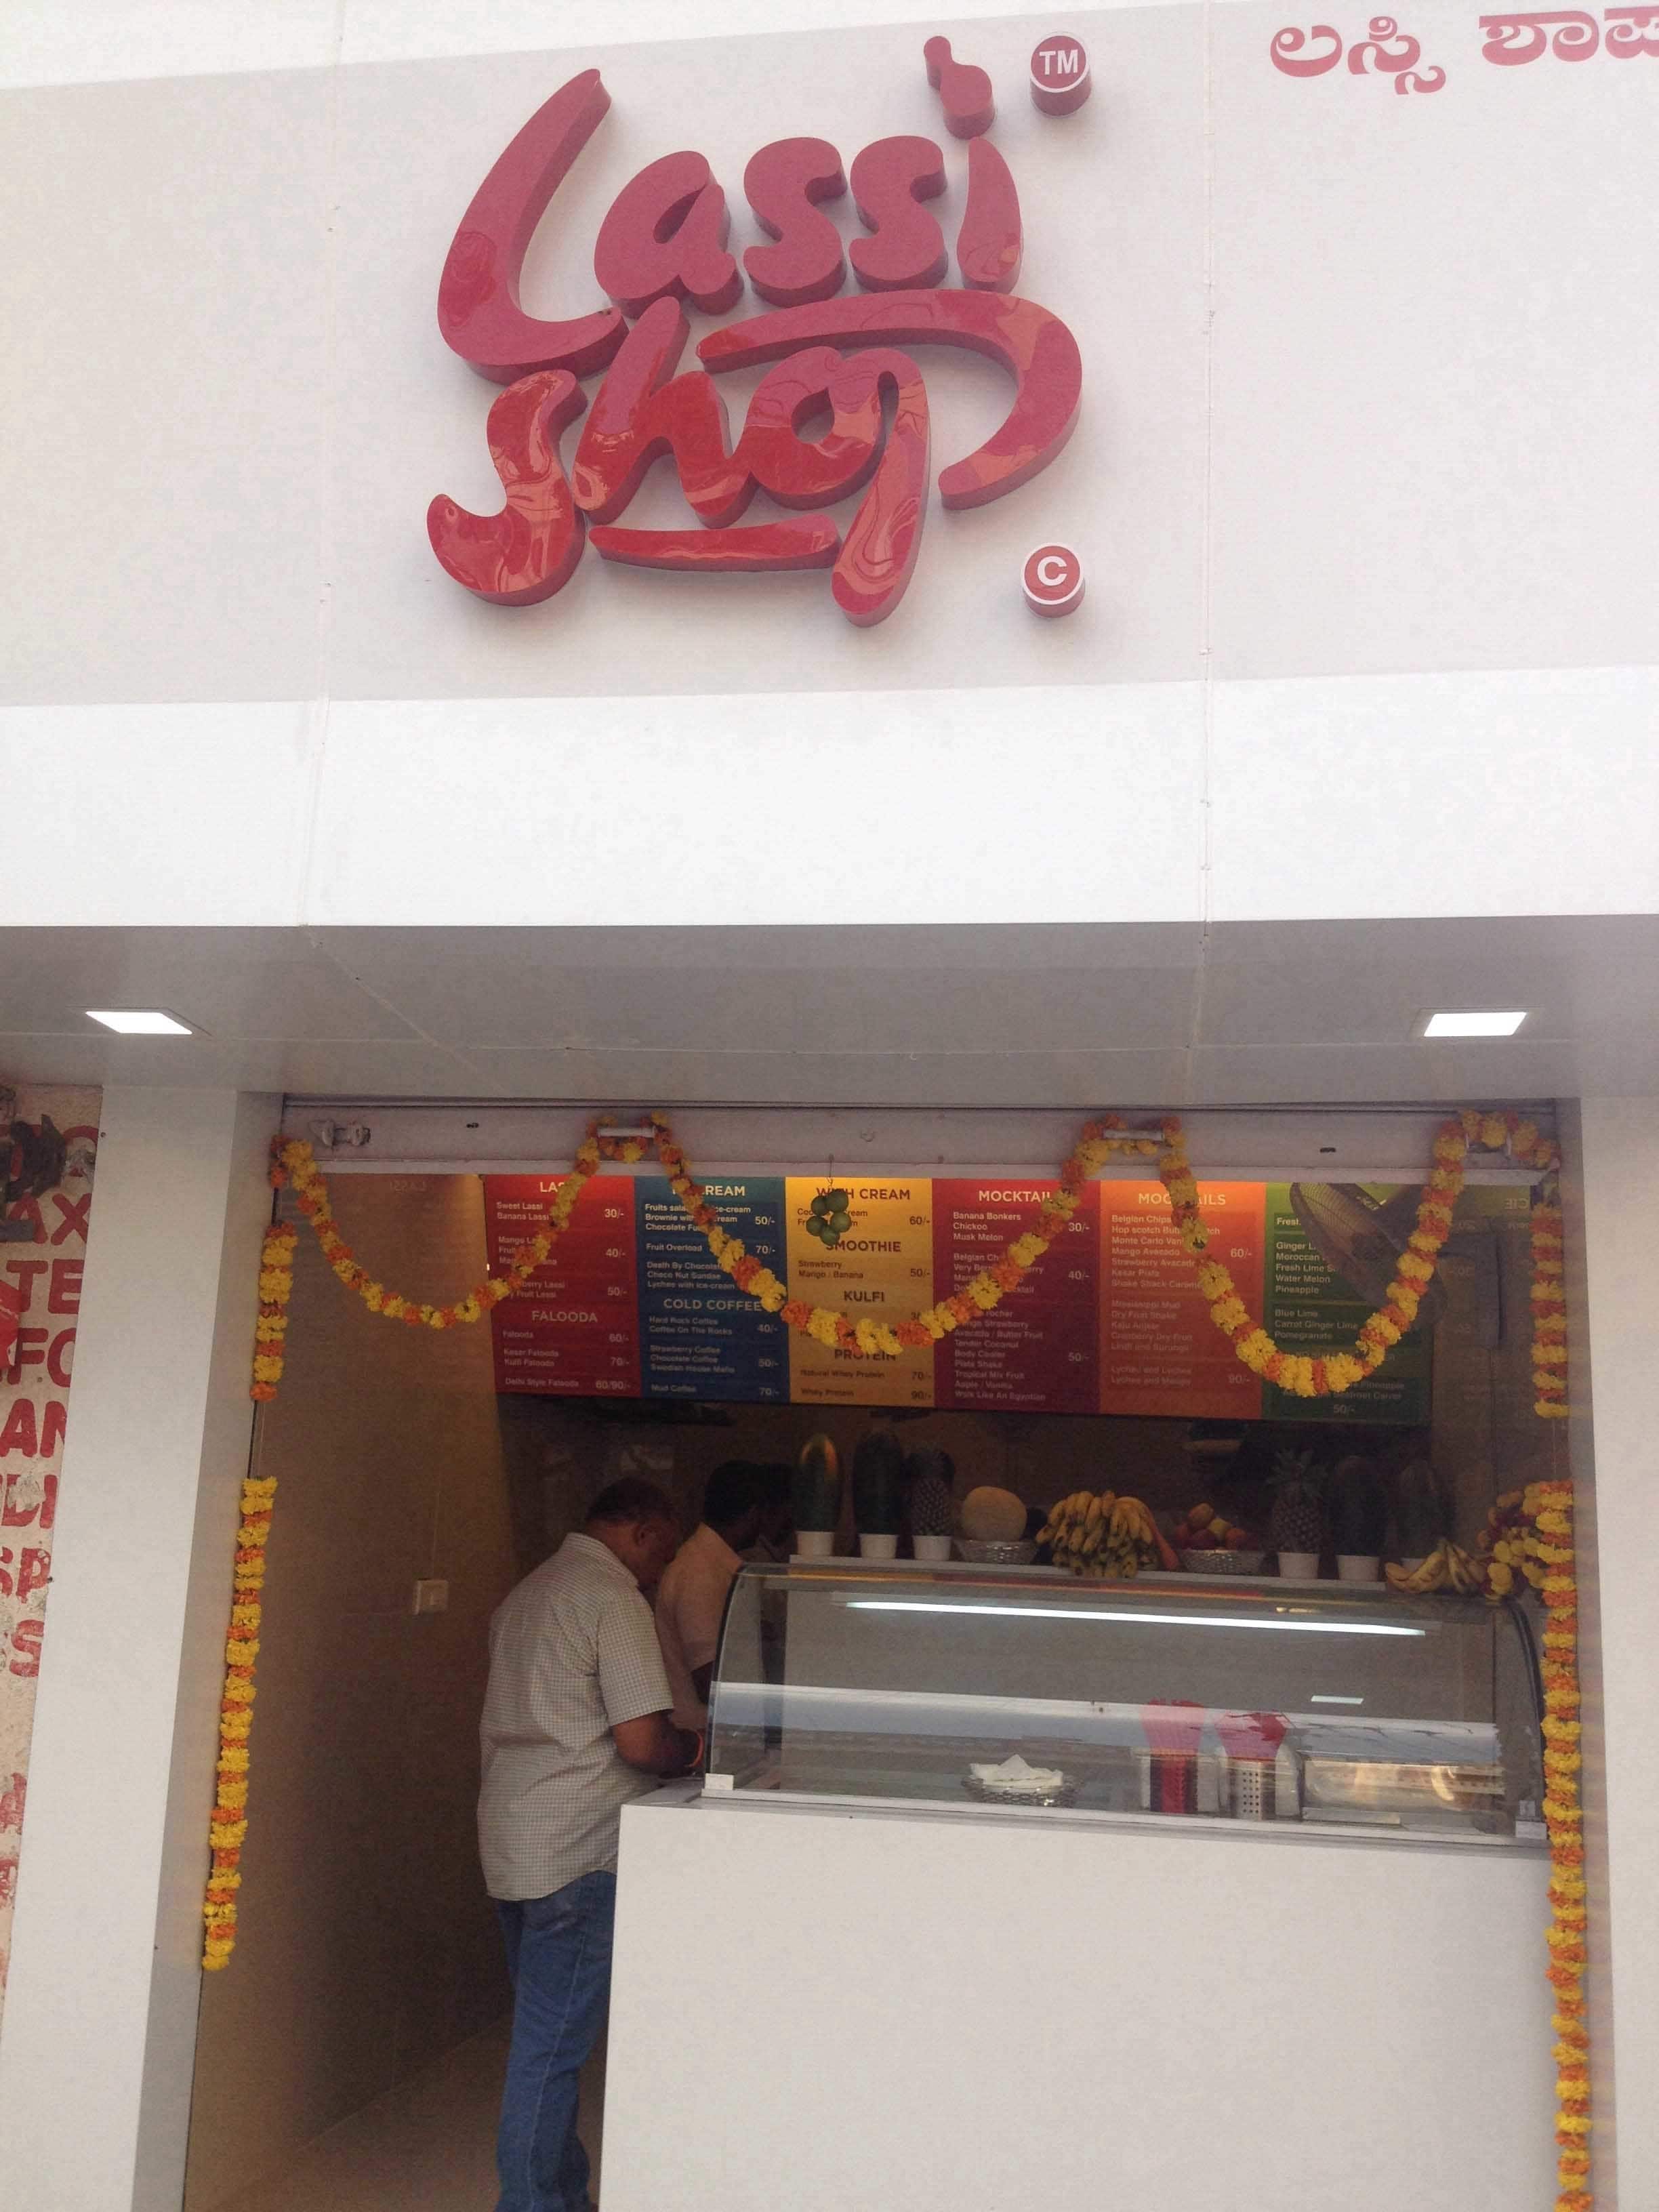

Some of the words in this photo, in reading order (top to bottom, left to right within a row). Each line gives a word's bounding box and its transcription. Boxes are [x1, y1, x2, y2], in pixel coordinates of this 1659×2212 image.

[1039, 49, 1078, 75] TM
[437, 36, 1023, 386] Lassi
[703, 1185, 745, 1197] REAM
[859, 1189, 911, 1200] CREAM
[495, 1201, 520, 1210] Sweet
[522, 1202, 543, 1210] Lassi
[644, 1204, 668, 1212] Fruits
[497, 1212, 527, 1220] Banana
[604, 1208, 624, 1219] 30/-
[953, 1211, 984, 1220] Banana
[987, 1212, 1021, 1221] Bonkers
[754, 1216, 775, 1225] 50/-
[909, 1216, 930, 1225] 60/-
[1111, 1214, 1144, 1224] Belgian
[953, 1223, 988, 1231] Chickoo
[1068, 1223, 1090, 1233] 30/-
[1111, 1226, 1130, 1235] Hop
[498, 1236, 525, 1245] Mango
[1111, 1236, 1138, 1244] Monte
[646, 1243, 664, 1251] Fruit
[666, 1244, 702, 1252] Overload
[755, 1245, 775, 1254] 70/-
[1275, 1242, 1306, 1251] Ginger
[605, 1247, 626, 1258] 40/-
[1230, 1248, 1252, 1258] 60/-
[1275, 1252, 1320, 1261] Moroccan
[954, 1253, 985, 1262] Belgian
[798, 1260, 842, 1269] Strawberry
[954, 1264, 971, 1273] Very
[1275, 1263, 1300, 1272] Fresh
[1303, 1264, 1326, 1272] Lime
[910, 1269, 930, 1278] 50/-
[1068, 1270, 1090, 1279] 40/-
[1275, 1275, 1301, 1283] Water
[1304, 1275, 1331, 1284] Melon
[607, 1286, 628, 1296] 50/-
[1275, 1286, 1319, 1295] Pineapple
[843, 1290, 885, 1302] KULFI
[663, 1298, 703, 1309] COLD
[706, 1299, 762, 1312] COFFEE
[531, 1310, 598, 1323] FALOODA
[1069, 1351, 1090, 1361] 50/-
